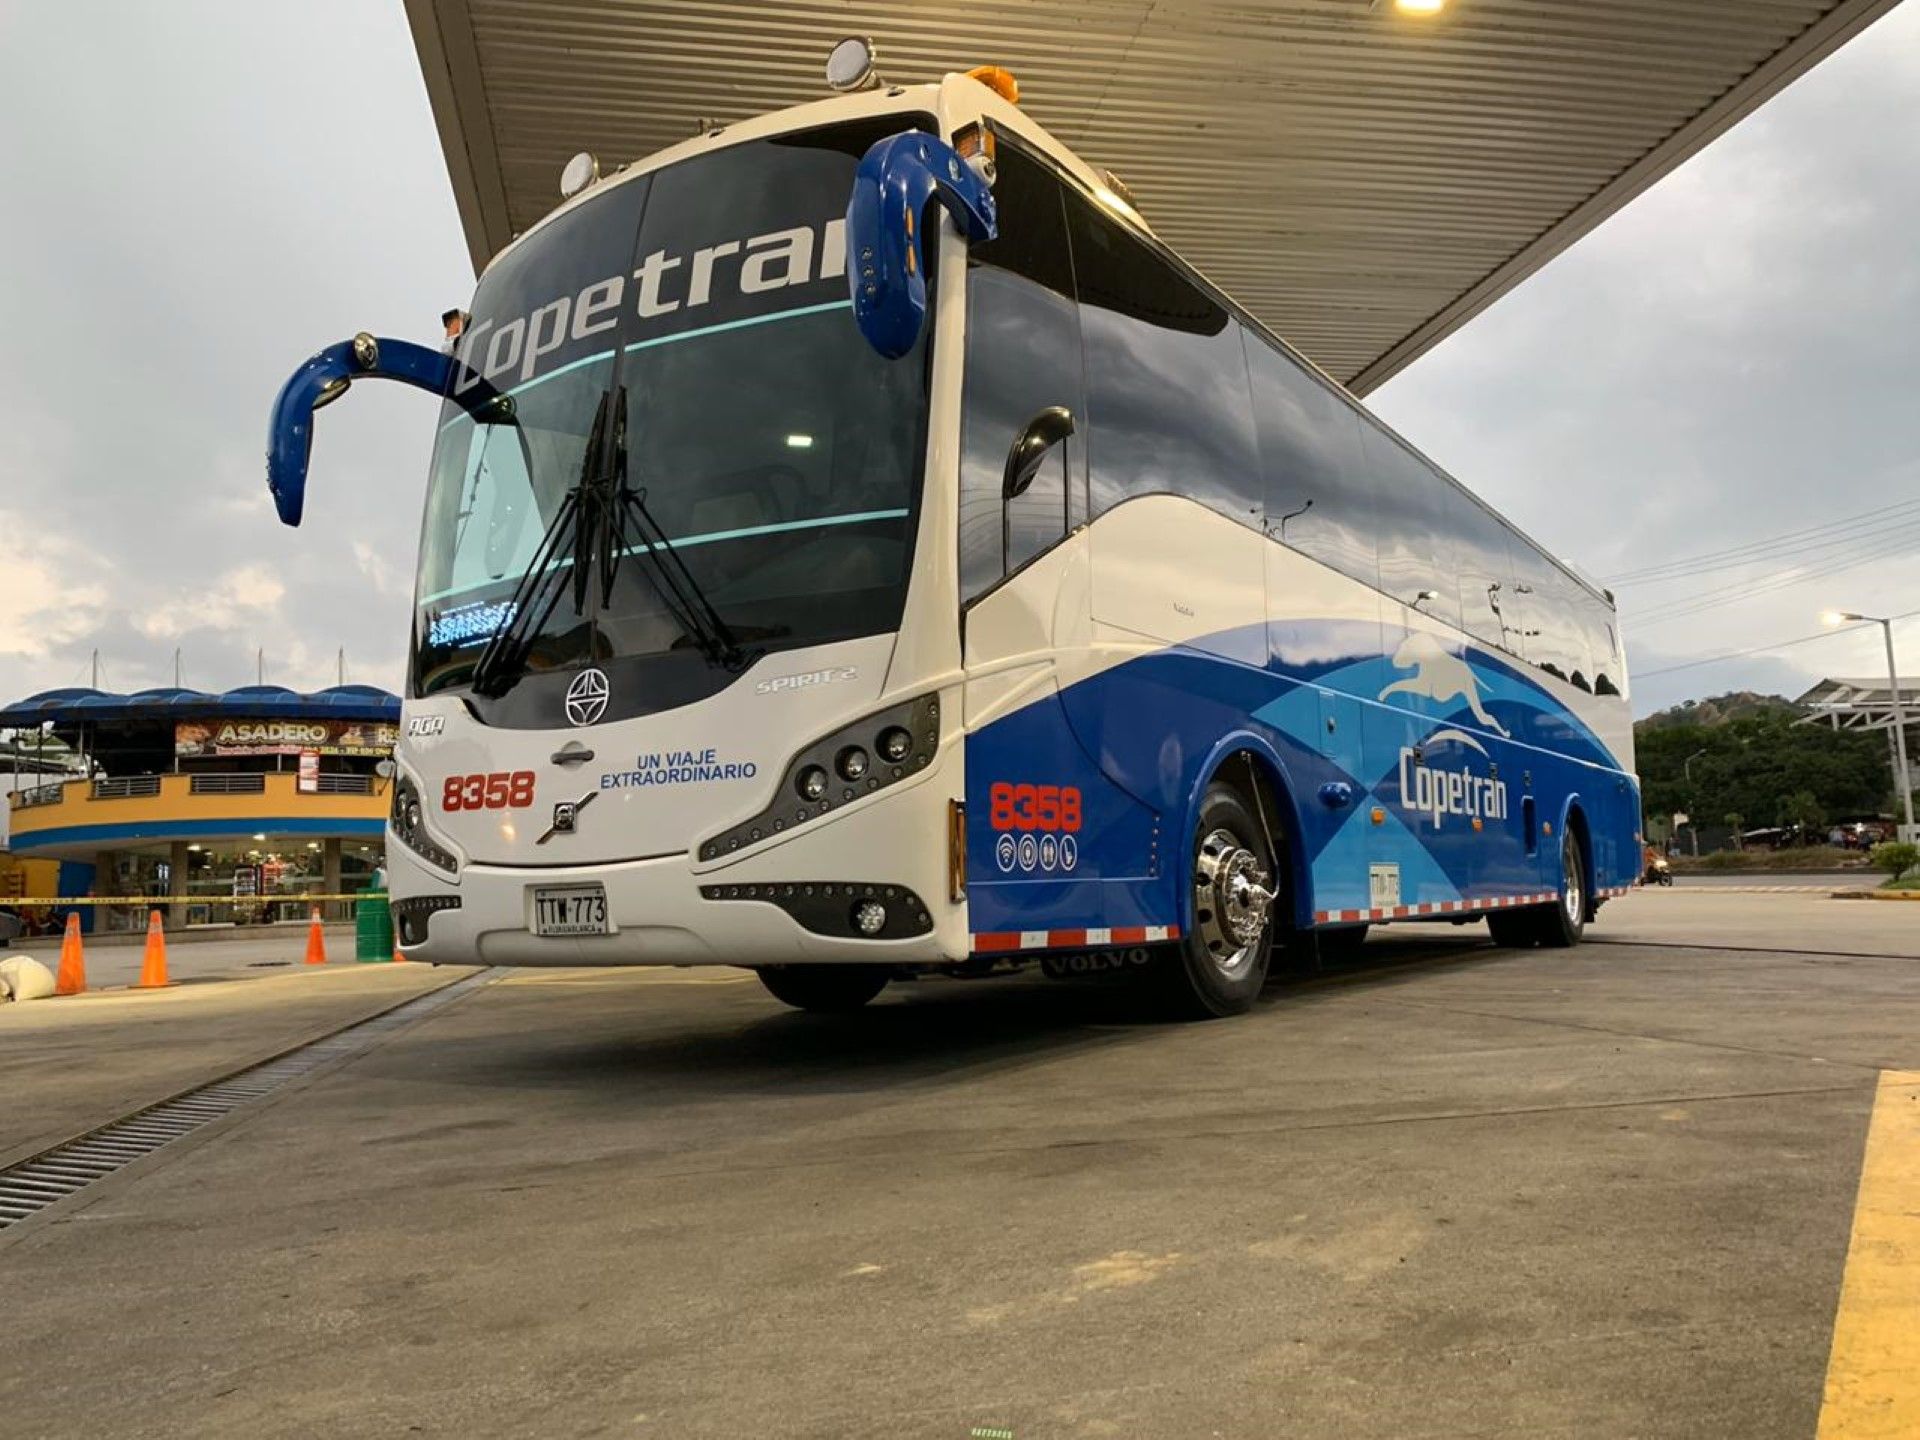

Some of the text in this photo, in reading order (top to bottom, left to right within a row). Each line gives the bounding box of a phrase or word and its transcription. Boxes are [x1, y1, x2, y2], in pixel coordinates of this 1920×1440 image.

[757, 669, 835, 694] SPIRIT
[219, 723, 326, 742] ASADERO
[637, 749, 716, 769] UN VIAJE
[600, 762, 756, 789] EXTRAORDINARIO
[1399, 746, 1507, 829] Copetran
[443, 771, 536, 812] 8358
[990, 782, 1082, 832] 8358
[1047, 947, 1150, 974] VOLVO
